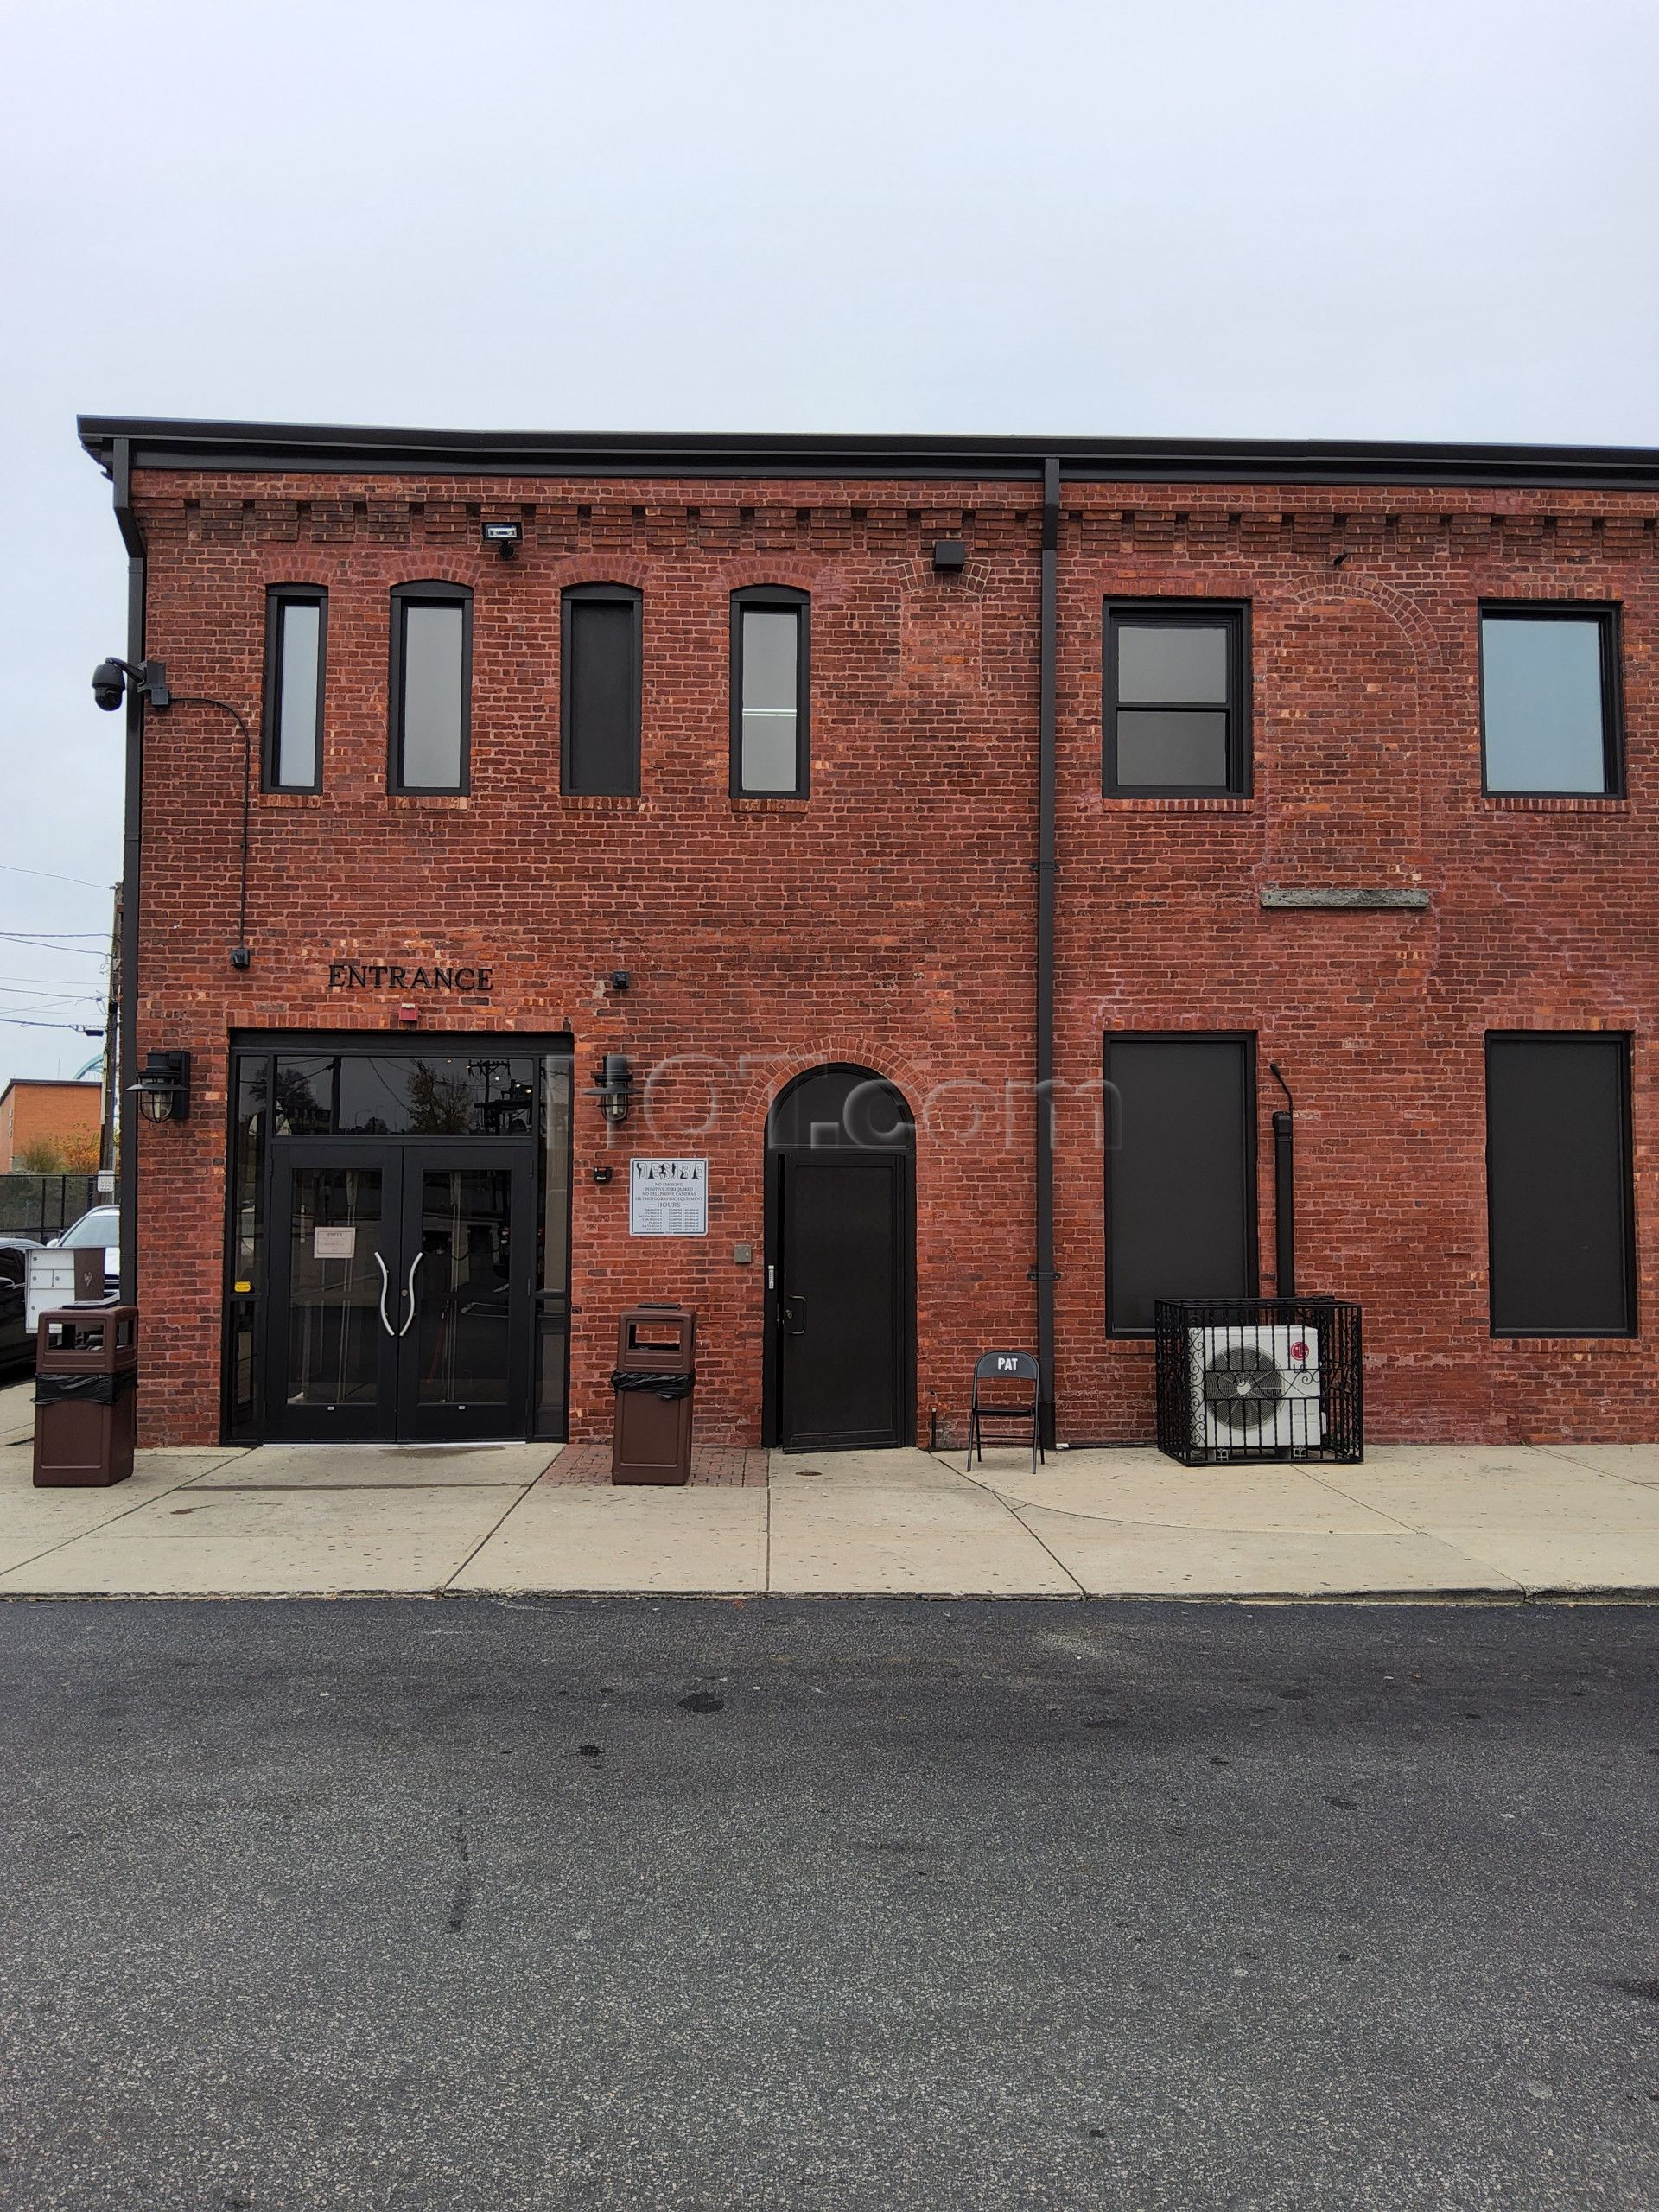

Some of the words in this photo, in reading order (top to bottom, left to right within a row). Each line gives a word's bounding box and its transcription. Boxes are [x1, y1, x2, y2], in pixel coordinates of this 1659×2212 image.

[327, 964, 493, 990] ENTRANCE
[637, 1162, 703, 1180] DESIRE
[997, 1357, 1019, 1370] PAT
